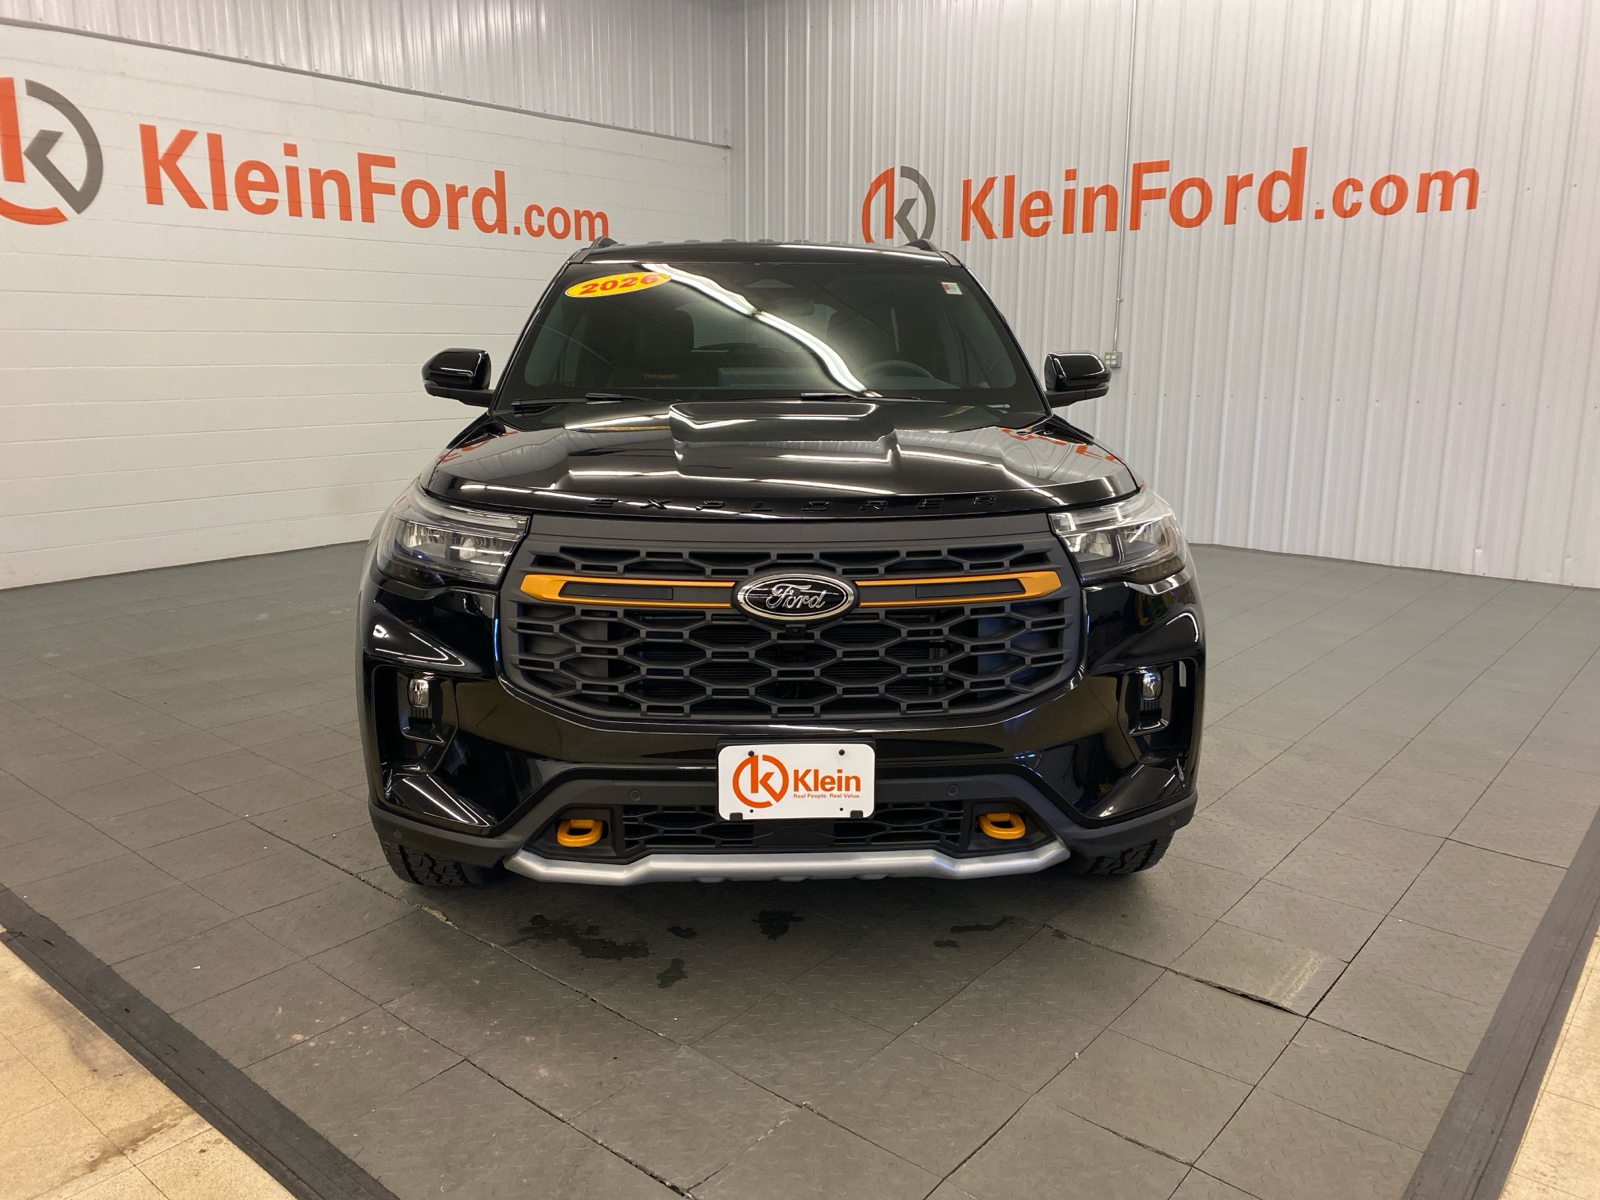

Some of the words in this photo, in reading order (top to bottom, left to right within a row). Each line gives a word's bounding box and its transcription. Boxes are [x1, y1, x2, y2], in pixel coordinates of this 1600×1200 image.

[139, 123, 609, 240] KleinFord.com
[961, 147, 1479, 241] KleinFord.com
[578, 274, 658, 295] 2026
[587, 495, 996, 512] EXPLORER
[765, 583, 827, 609] Ford
[793, 769, 861, 791] Klein
